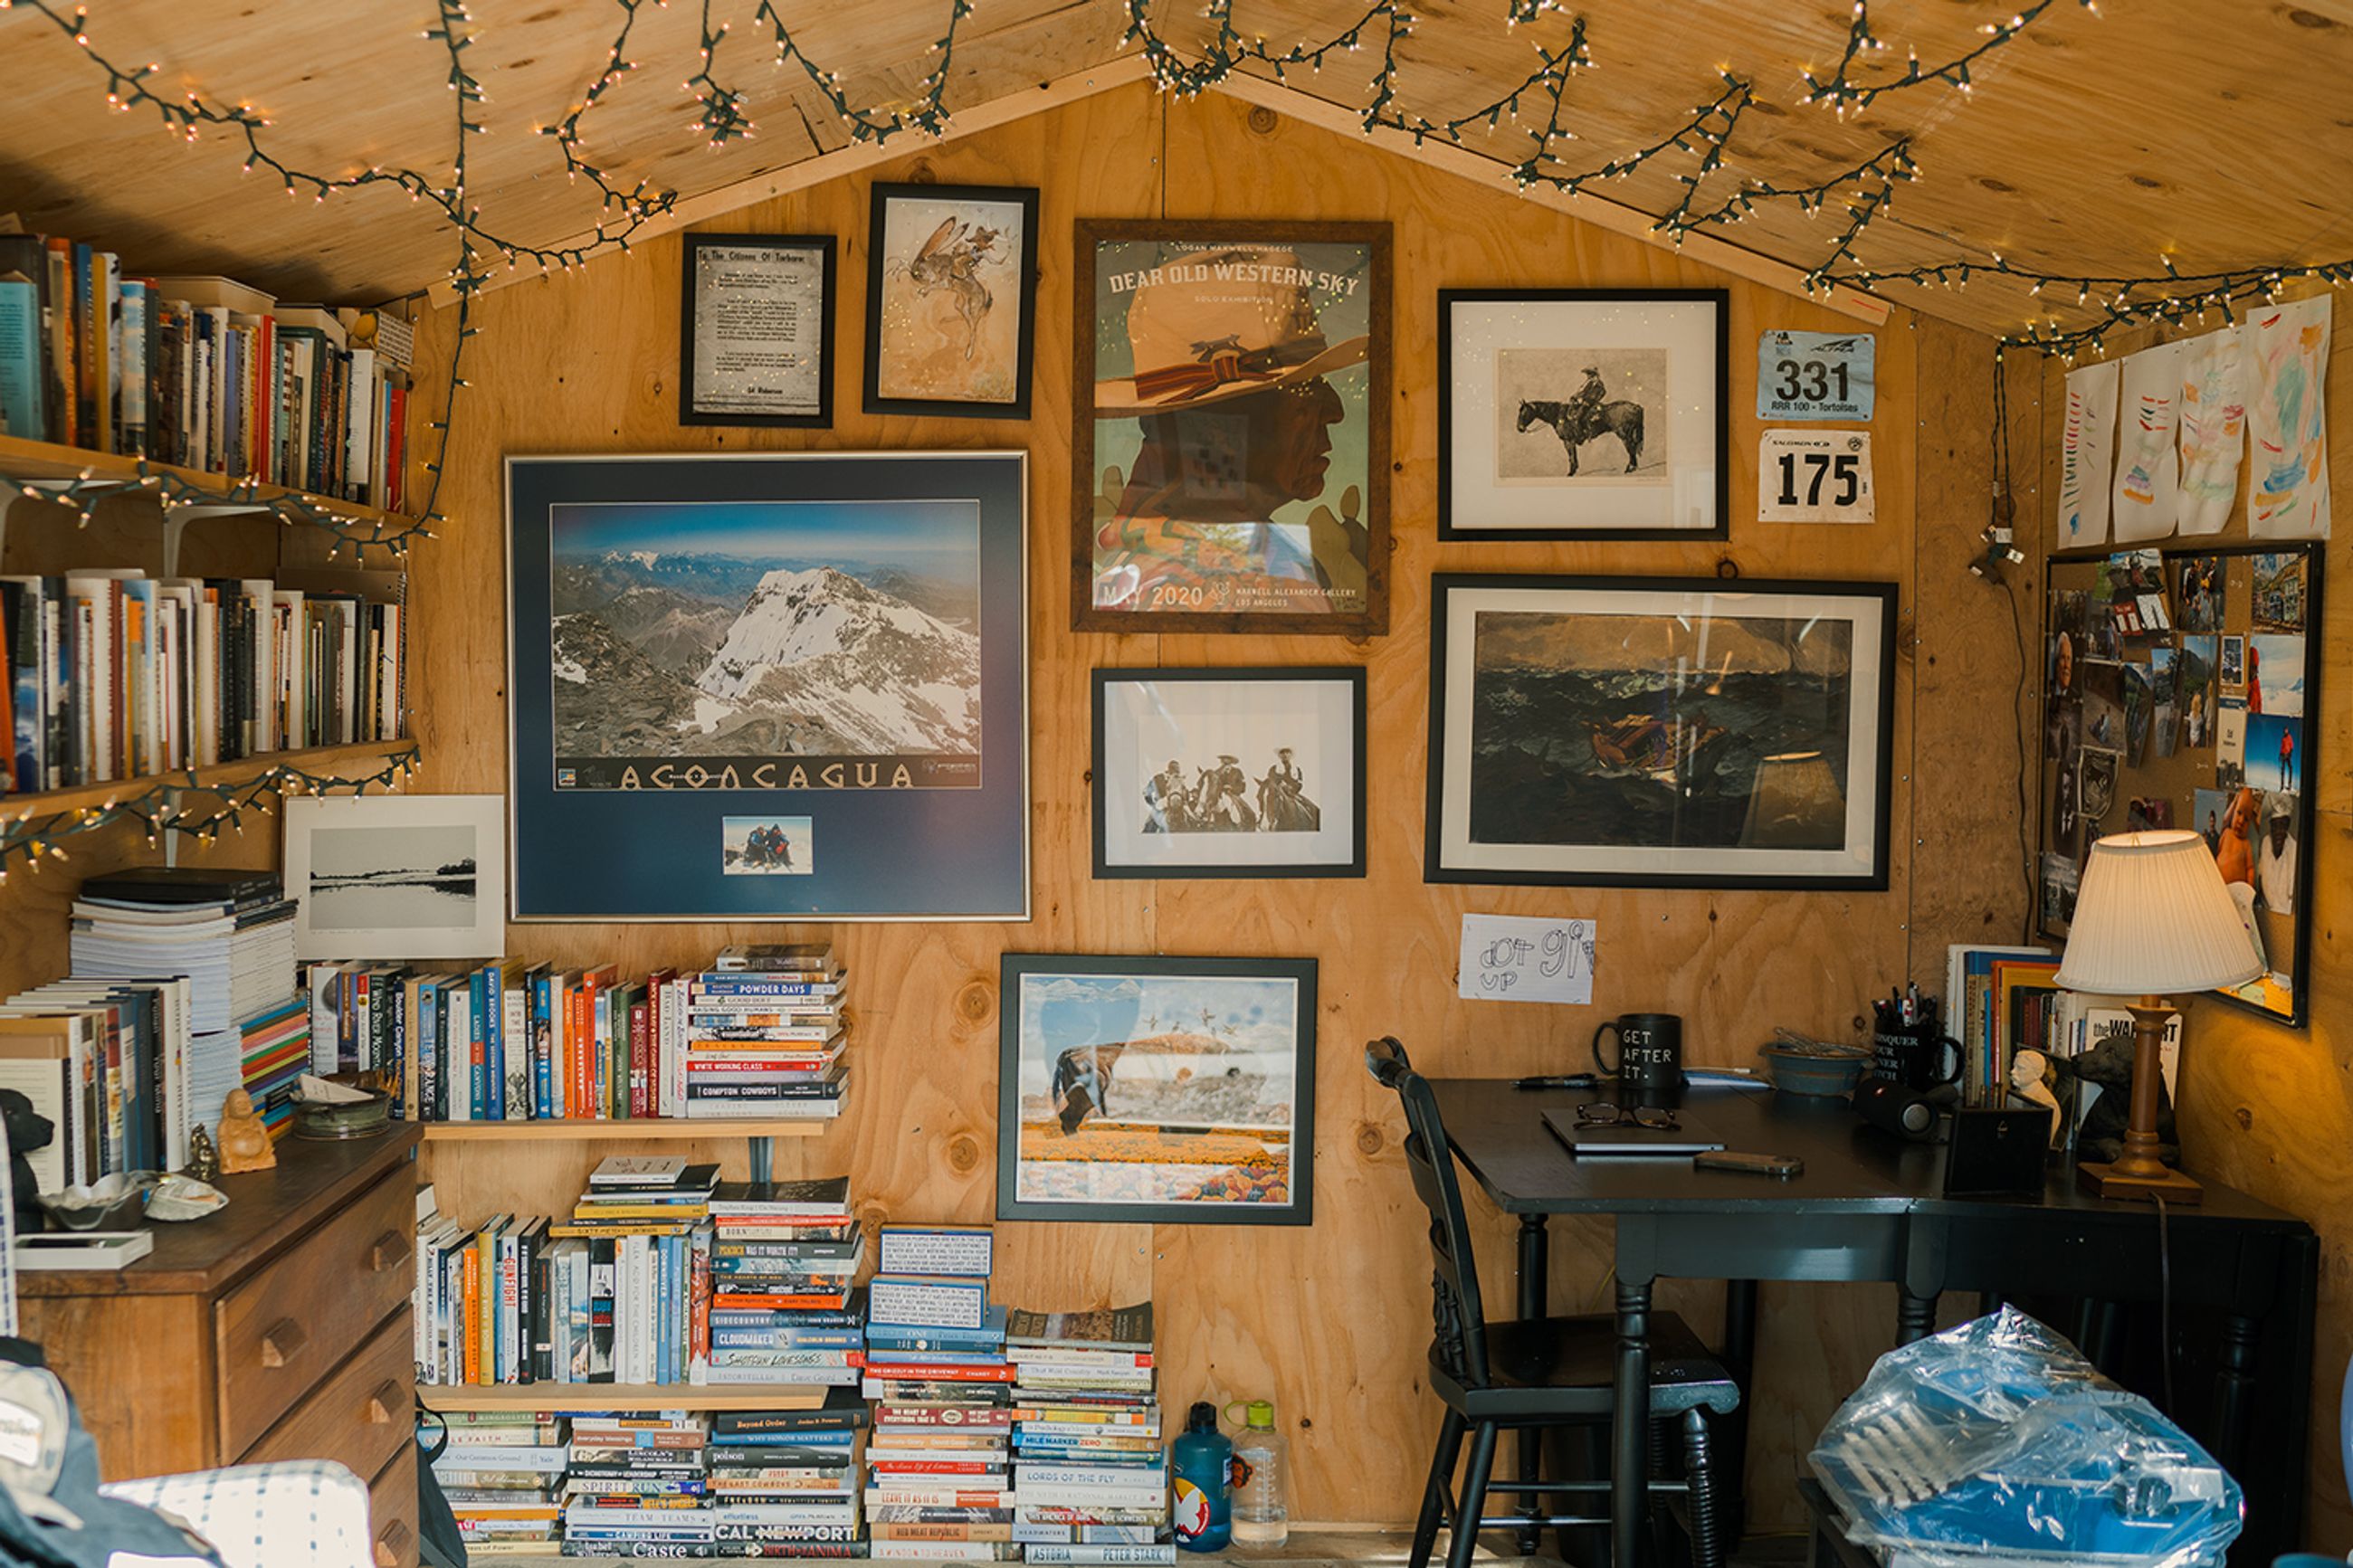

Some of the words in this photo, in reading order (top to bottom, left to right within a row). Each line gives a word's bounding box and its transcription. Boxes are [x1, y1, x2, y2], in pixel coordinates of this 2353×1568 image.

[1175, 244, 1205, 253] LOGAN
[1209, 244, 1254, 253] MAXWELL
[711, 250, 725, 261] The
[729, 251, 757, 262] Citizens
[761, 252, 771, 262] Of
[1108, 268, 1166, 295] DEAR
[1168, 264, 1208, 284] OLD
[1212, 263, 1314, 289] WESTERN
[1316, 271, 1359, 297] SKY
[1194, 295, 1220, 304] SOLO
[1221, 295, 1274, 305] EXHIBITION
[1776, 359, 1848, 402] 331
[1770, 401, 1791, 412] RRR
[1793, 401, 1810, 412] 100
[1818, 402, 1859, 413] Tortoises
[1777, 452, 1859, 507] 175
[1103, 585, 1142, 605] MAY
[1152, 585, 1204, 606] 2020
[1273, 588, 1319, 596] ALEXANDER
[1235, 598, 1253, 607] LOS
[1253, 598, 1288, 608] ANGELES
[488, 972, 496, 995] DAVID
[739, 984, 779, 995] POWDER
[780, 984, 806, 995] DAYS
[489, 997, 497, 1029] BROOKS
[2092, 1022, 2110, 1037] the
[392, 1025, 405, 1058] Canyon
[1622, 1029, 1653, 1045] GET
[1623, 1048, 1672, 1064] AFTER
[742, 1061, 764, 1070] CLASS
[1624, 1064, 1651, 1080] IT.
[702, 1086, 738, 1097] COMPTON
[740, 1086, 776, 1097] COWBOYS
[503, 1257, 516, 1308] GUNFIGHT
[715, 1316, 771, 1325] SIDECOUNTRY
[737, 1420, 765, 1430] Beyond
[765, 1418, 787, 1428] Order
[468, 1435, 502, 1443] FAITH
[1046, 1438, 1079, 1446] MARKER
[1079, 1439, 1101, 1447] ZERO
[538, 1455, 555, 1463] Yale
[1027, 1472, 1059, 1482] LORDS
[1061, 1473, 1074, 1482] OF
[1077, 1474, 1095, 1483] THE
[1098, 1475, 1116, 1484] FLY
[582, 1482, 630, 1493] SPIRIT
[632, 1483, 662, 1493] RUN
[881, 1491, 903, 1504] LEAVE
[723, 1512, 760, 1521] effortless
[715, 1525, 753, 1541] CAL
[756, 1525, 855, 1541] NEWPORT
[910, 1526, 929, 1537] MEAT
[929, 1526, 961, 1537] REPUBLIC
[1017, 1529, 1066, 1537] HEADWATERS
[632, 1542, 688, 1559] Caste
[763, 1544, 793, 1558] BIRTH
[932, 1548, 967, 1558] HEAVEN
[1033, 1548, 1072, 1562] ASTORIA
[1102, 1548, 1131, 1562] PETER
[1133, 1548, 1162, 1562] STARK
